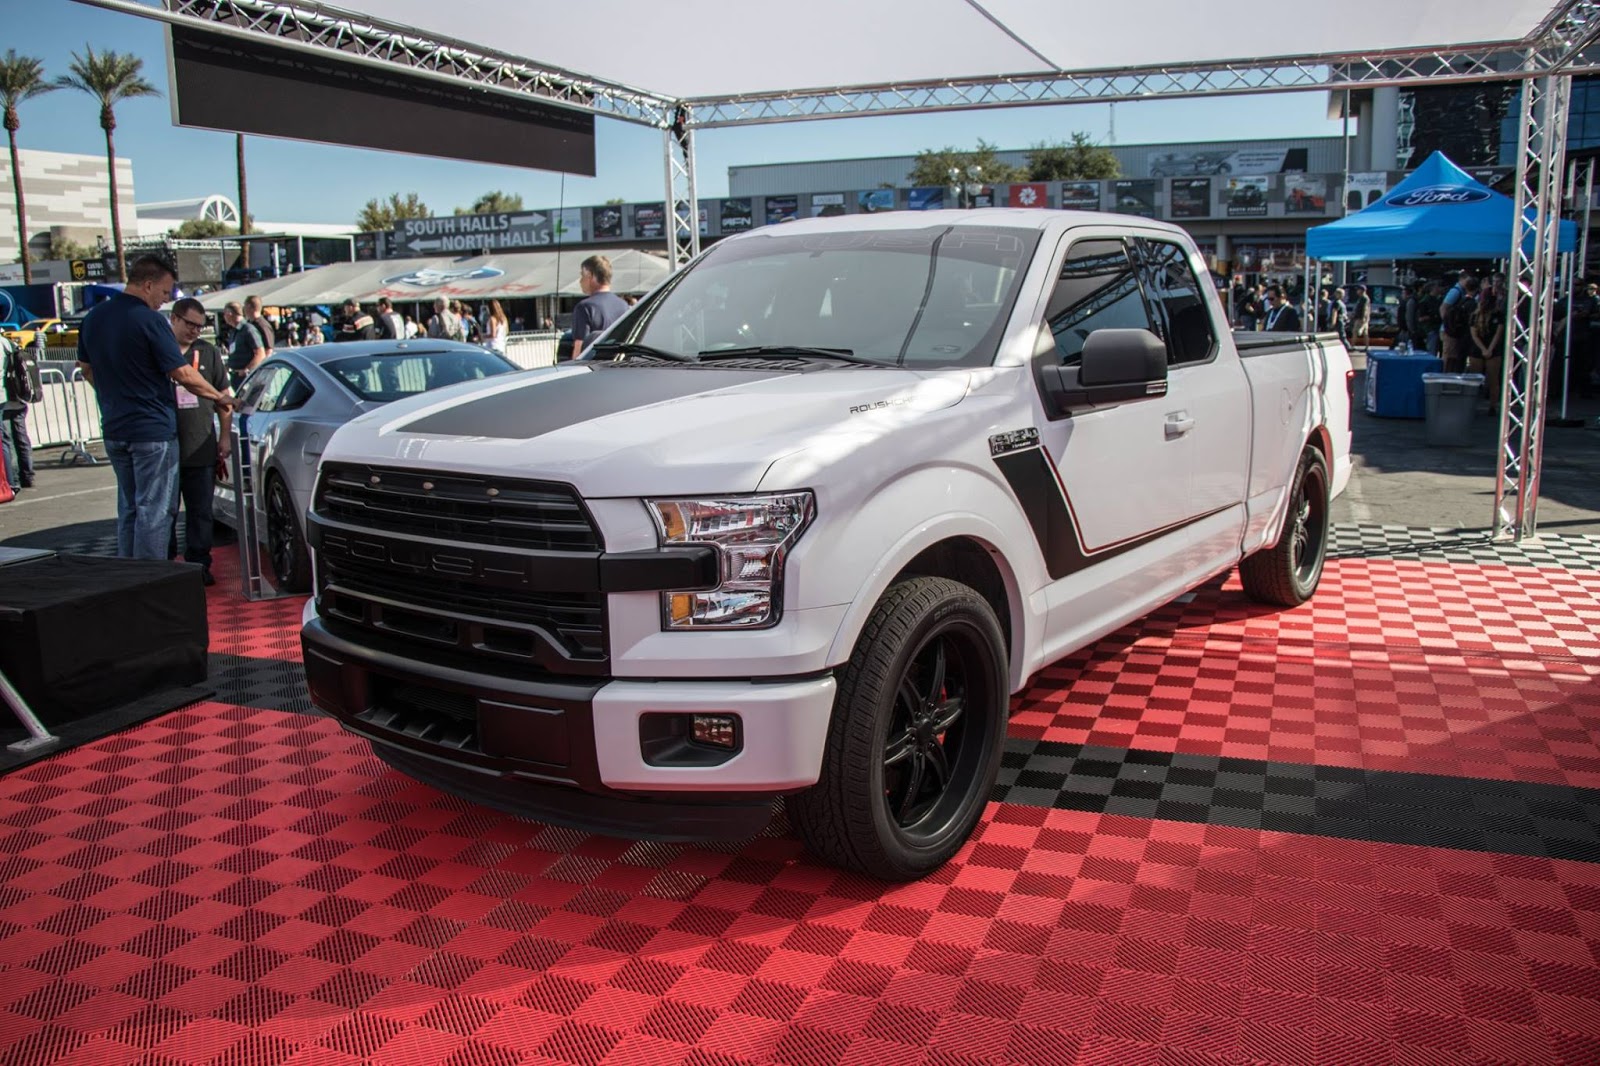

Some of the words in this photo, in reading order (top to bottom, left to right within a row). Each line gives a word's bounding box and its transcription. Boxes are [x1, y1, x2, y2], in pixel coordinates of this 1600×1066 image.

[1404, 188, 1470, 205] Ford
[405, 220, 455, 236] SOUTH
[460, 215, 508, 232] HALLS
[442, 235, 495, 250] NORTH
[500, 230, 550, 248] HALLS
